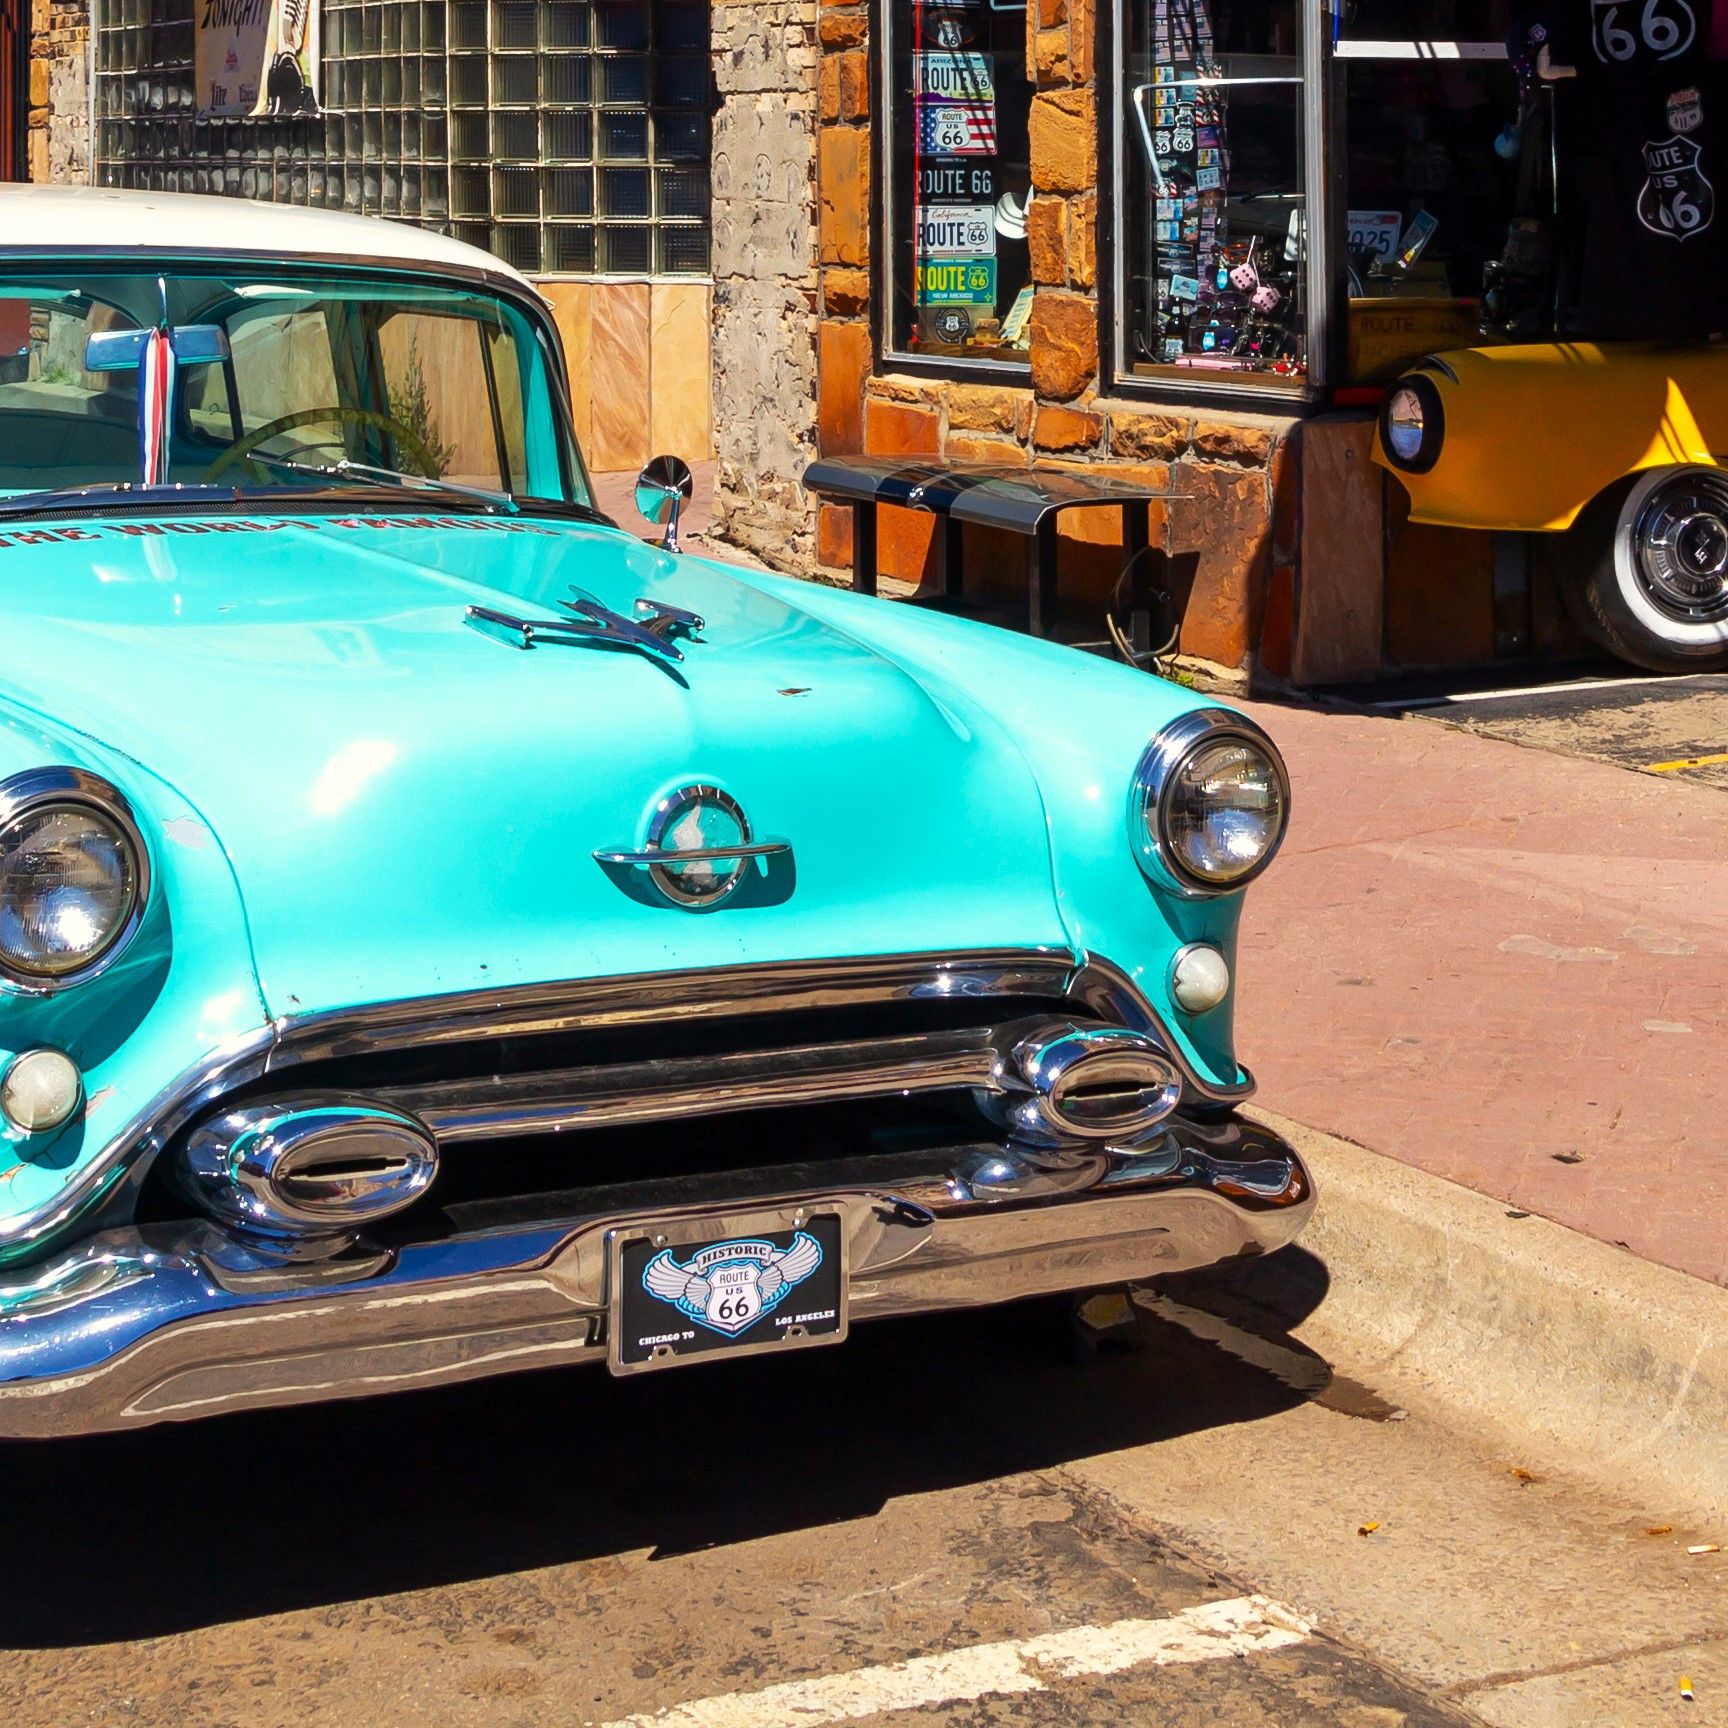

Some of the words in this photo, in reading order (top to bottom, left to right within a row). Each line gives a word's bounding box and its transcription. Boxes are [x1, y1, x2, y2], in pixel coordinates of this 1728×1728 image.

[922, 66, 969, 91] ROUTE
[941, 113, 962, 121] ROUTE
[941, 130, 964, 146] 66
[1176, 139, 1192, 151] 66
[972, 169, 992, 194] 66
[970, 230, 985, 242] 66
[701, 1244, 768, 1264] HISTORIC
[719, 1270, 750, 1285] ROUTE
[725, 1286, 744, 1296] US
[718, 1296, 750, 1321] 66
[775, 1314, 794, 1326] LOS
[795, 1308, 836, 1324] ANGELES
[638, 1332, 681, 1347] CHICAGO
[682, 1330, 695, 1340] TO
